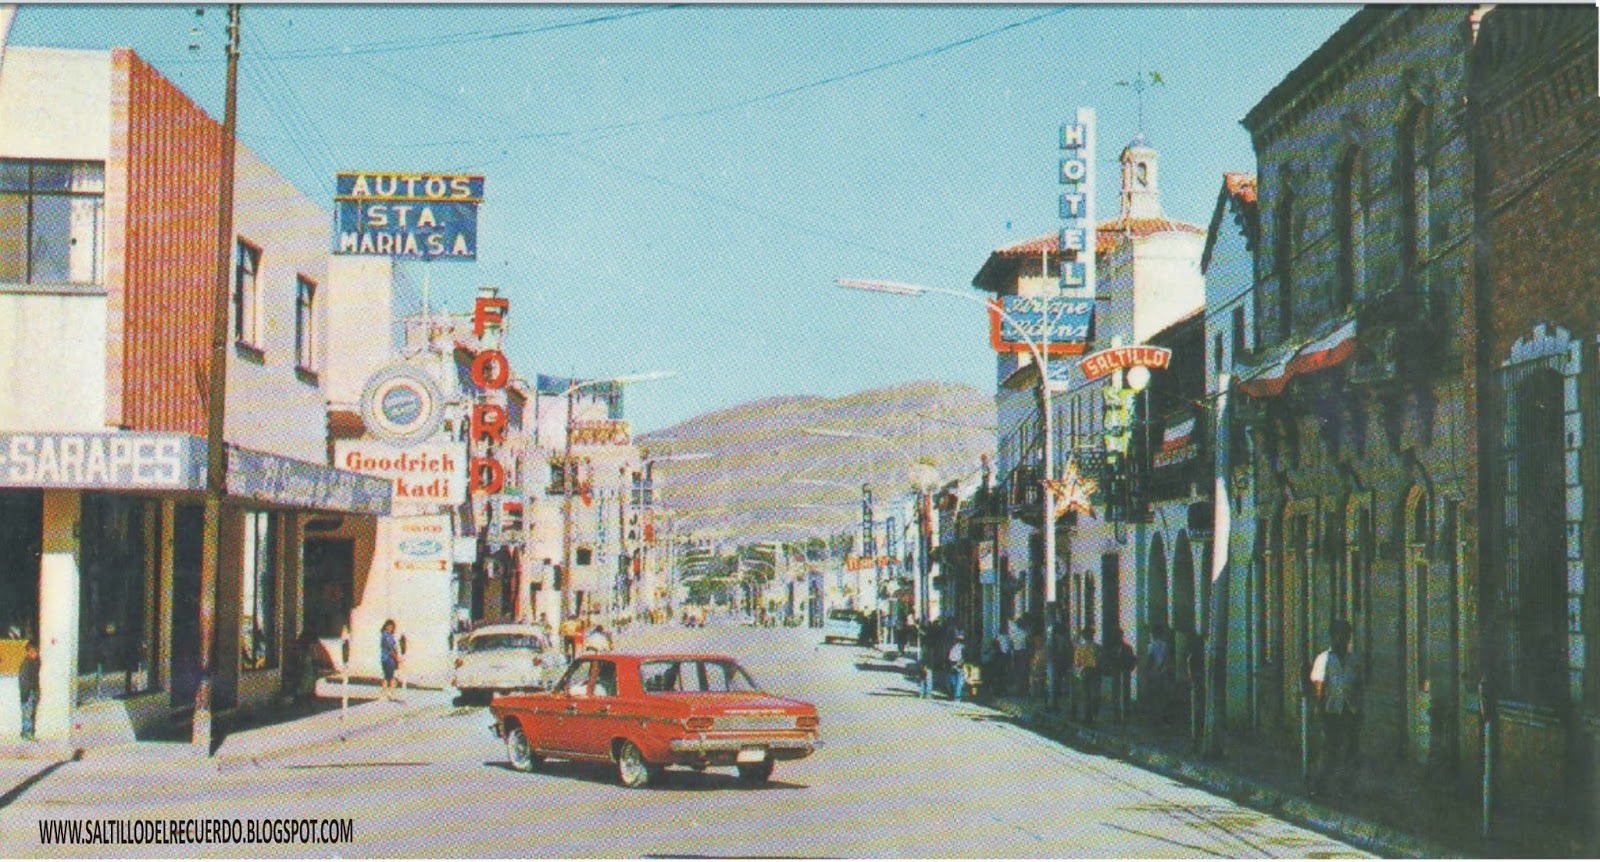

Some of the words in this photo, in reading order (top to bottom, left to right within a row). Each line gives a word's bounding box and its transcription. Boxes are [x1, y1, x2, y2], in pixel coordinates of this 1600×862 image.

[352, 175, 471, 199] AUTOS
[367, 205, 445, 228] STA.
[1062, 124, 1085, 285] HOTEL
[427, 233, 475, 256] S.A.
[1086, 349, 1164, 377] SALTILLO
[470, 298, 509, 494] FORD
[9, 435, 181, 484] SARAPES
[346, 452, 454, 471] Goodrich
